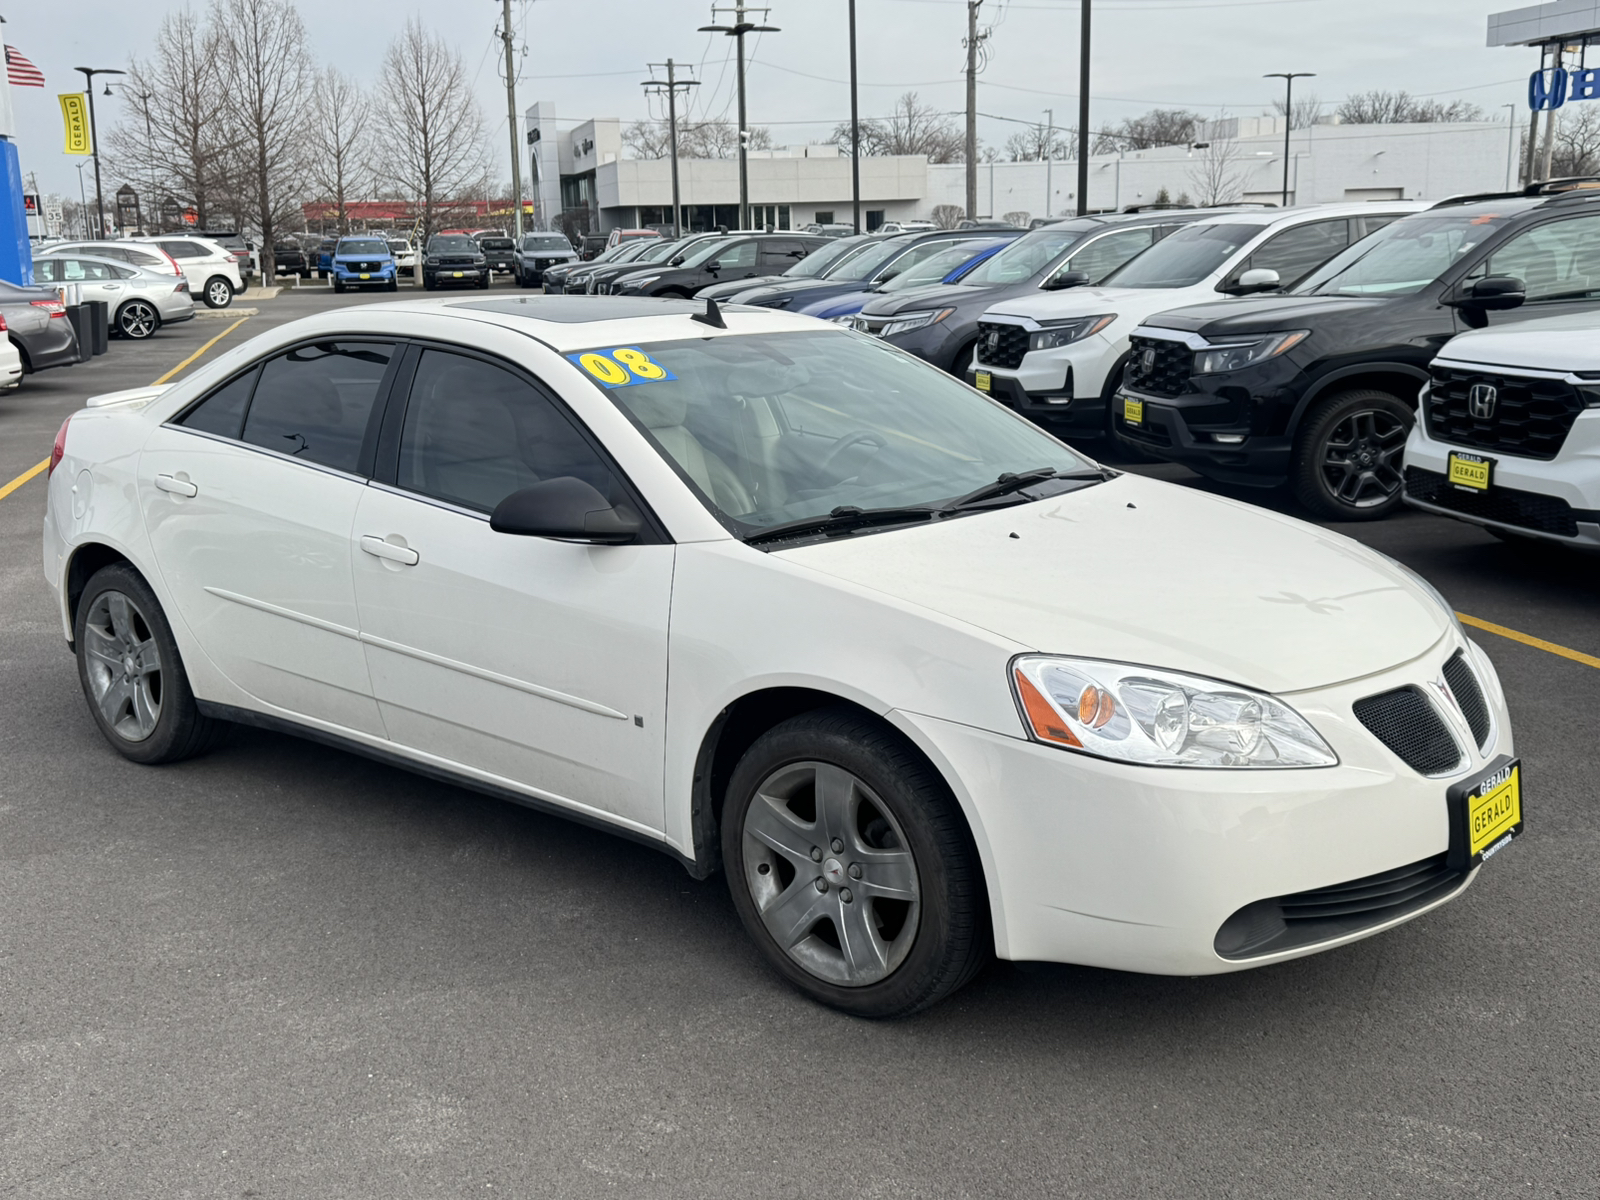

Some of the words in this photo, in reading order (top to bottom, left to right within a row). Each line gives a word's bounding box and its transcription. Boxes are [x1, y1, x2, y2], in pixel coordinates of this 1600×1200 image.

[69, 100, 82, 147] GERALD
[48, 212, 62, 221] 35
[579, 348, 667, 385] 08
[1457, 452, 1482, 463] GERALD
[1455, 466, 1485, 480] GERALD
[1480, 766, 1511, 796] GERALD
[1474, 794, 1511, 833] GERALD
[1482, 833, 1513, 861] COUNTRYSIDE
